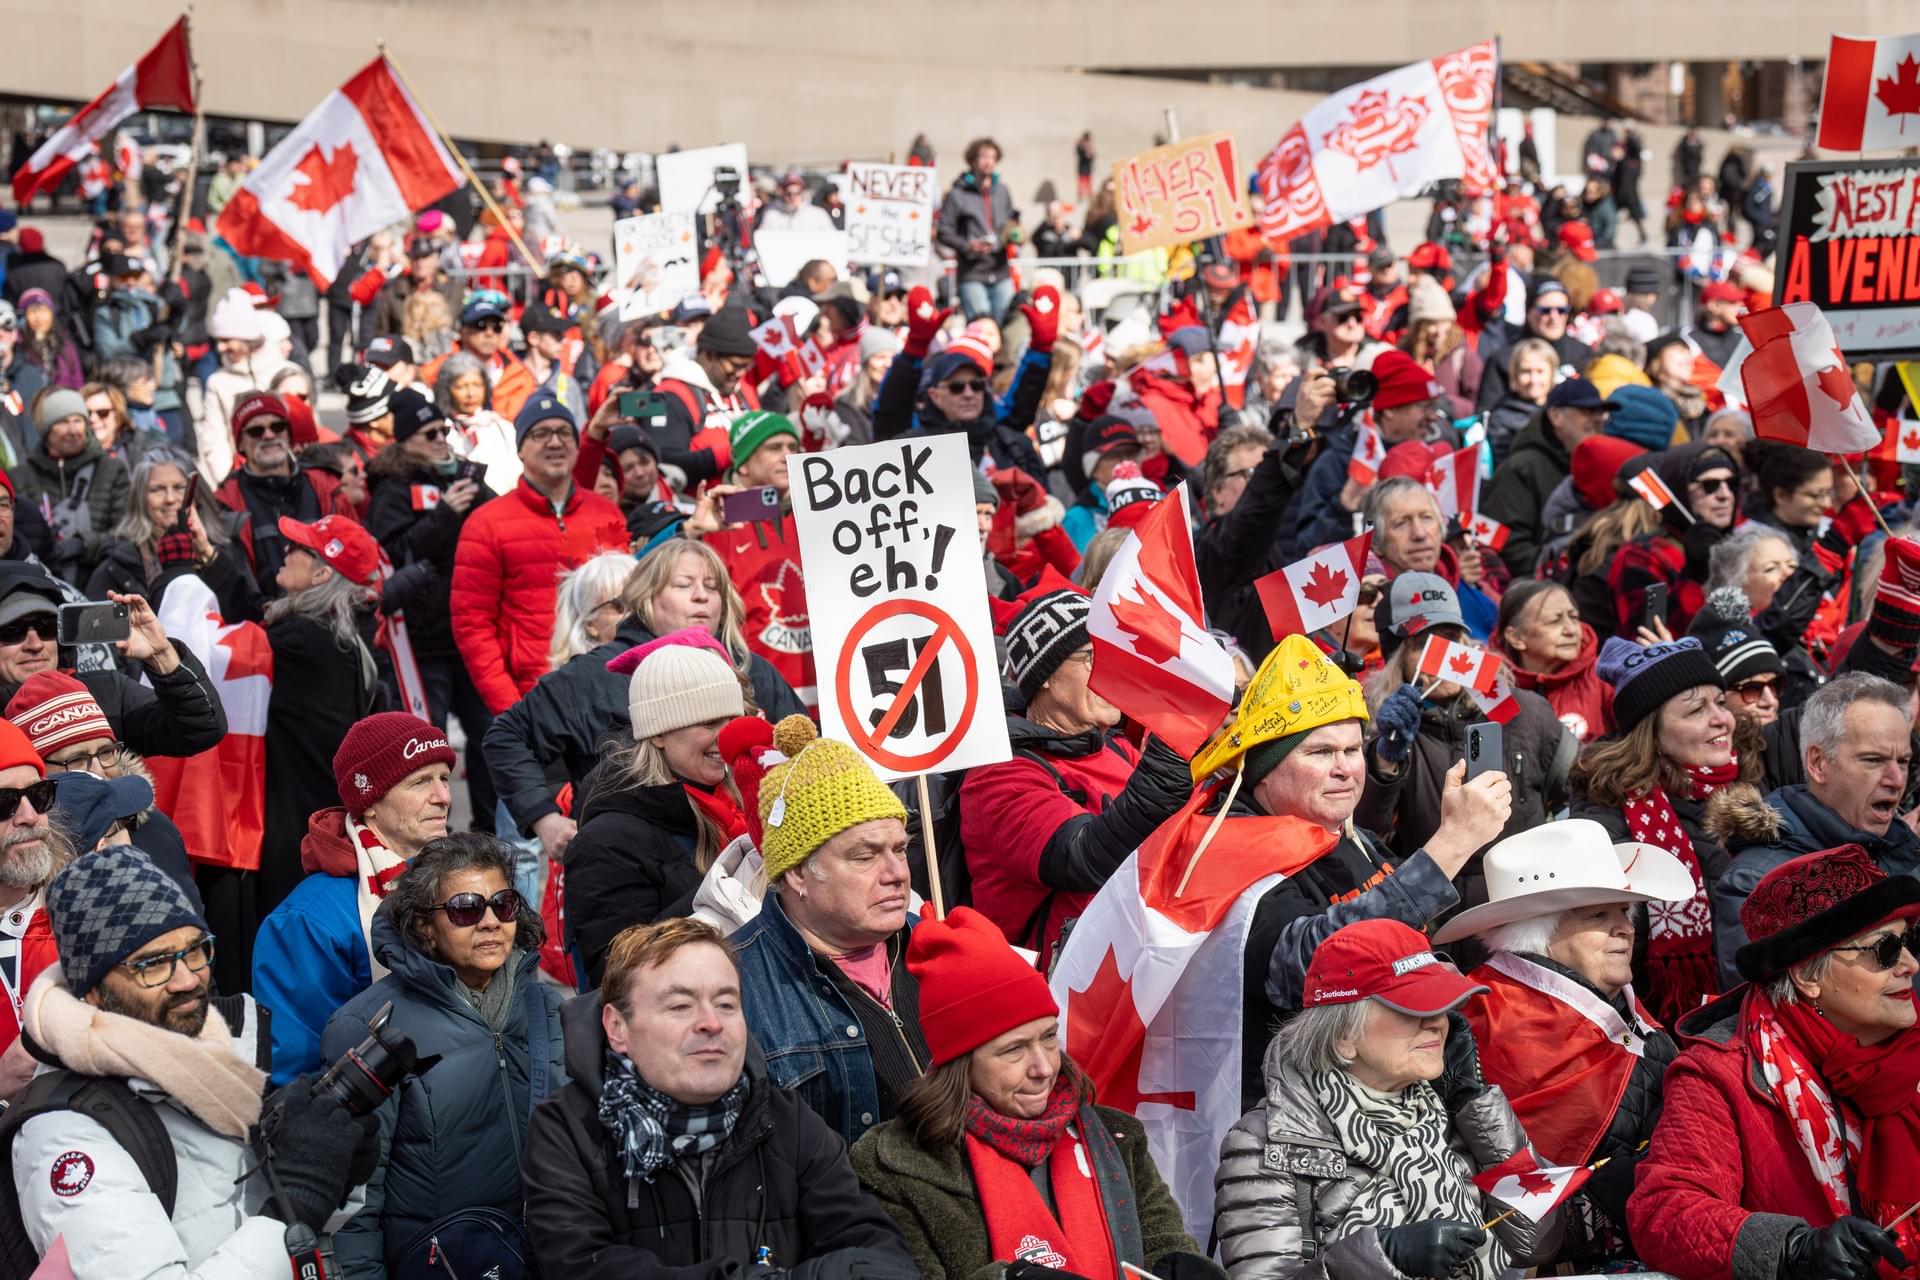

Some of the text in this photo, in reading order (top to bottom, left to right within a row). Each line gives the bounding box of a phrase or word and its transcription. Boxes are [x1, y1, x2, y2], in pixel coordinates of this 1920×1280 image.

[850, 168, 928, 199] NEVER
[1122, 150, 1214, 210] NEVER
[803, 444, 935, 511] Back
[832, 500, 930, 555] off,
[850, 523, 957, 598] eh!
[1422, 590, 1448, 602] CBC
[862, 634, 947, 739] 51
[1322, 988, 1359, 999] Scotiabank
[53, 1152, 84, 1172] CANADA
